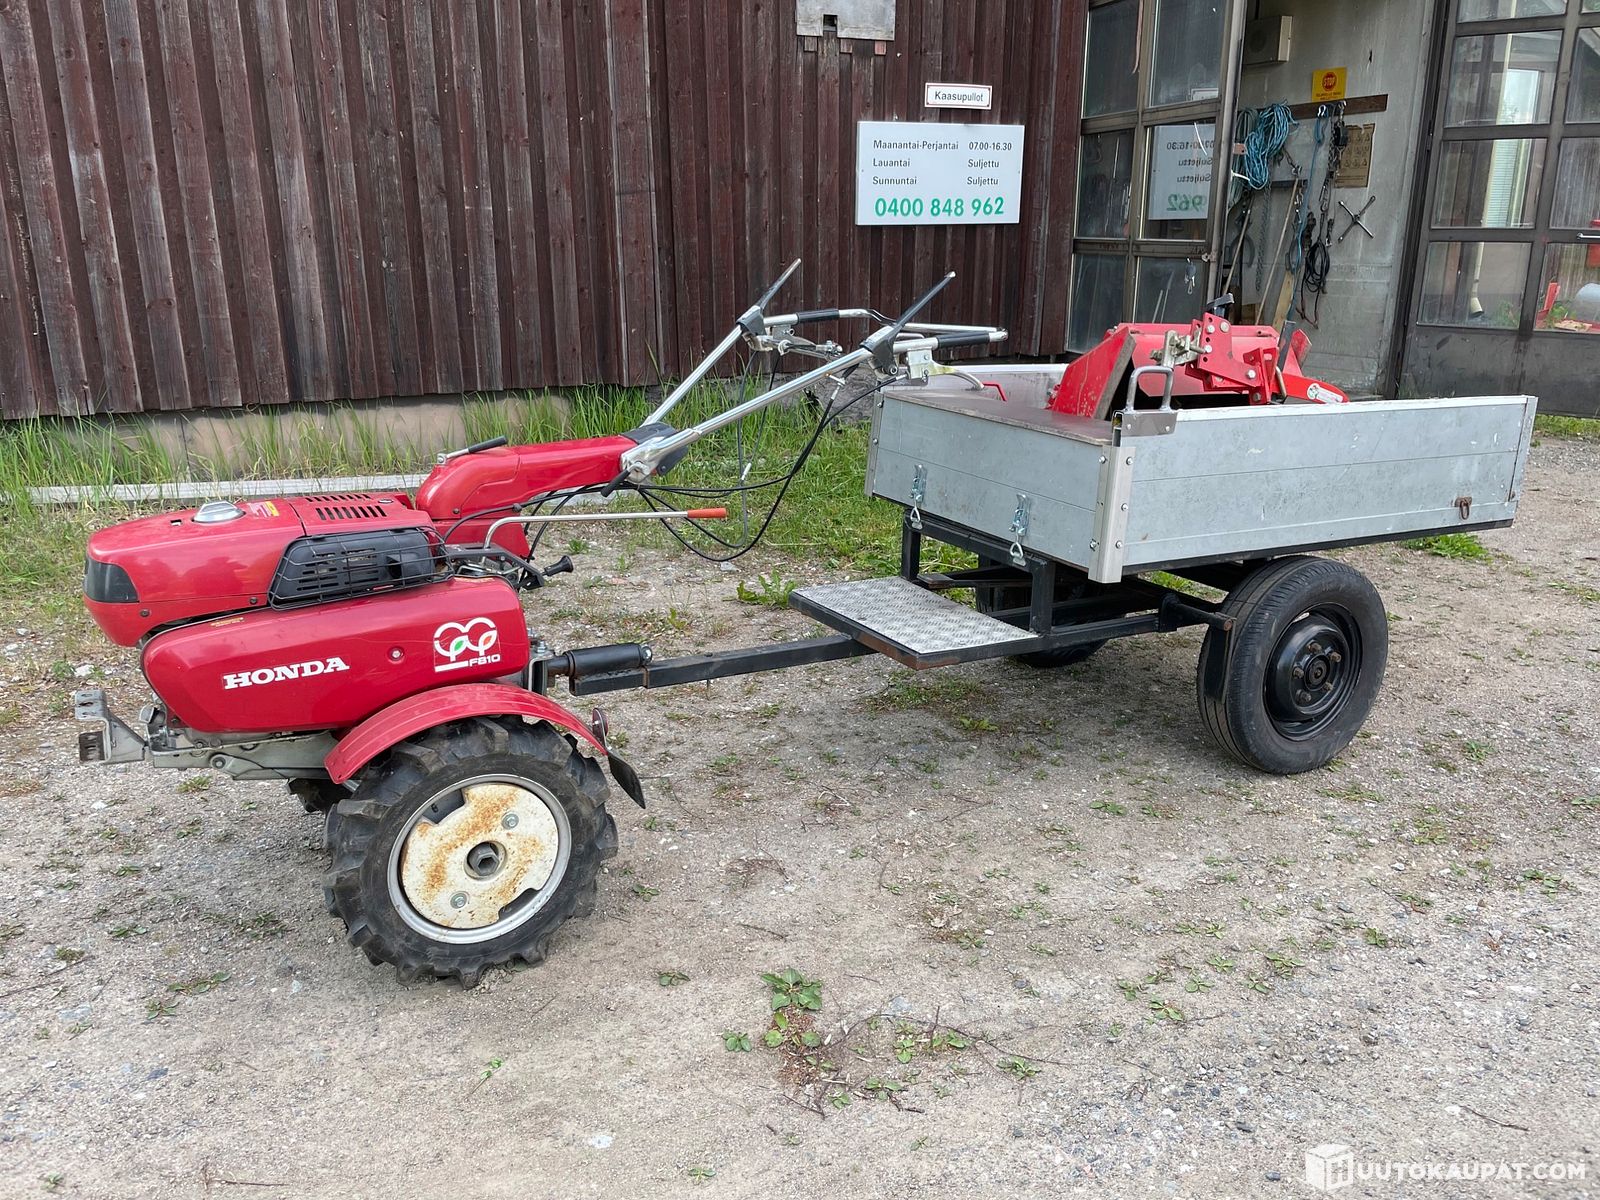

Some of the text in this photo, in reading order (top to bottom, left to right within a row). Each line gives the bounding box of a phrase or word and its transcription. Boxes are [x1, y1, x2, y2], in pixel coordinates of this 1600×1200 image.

[934, 91, 983, 103] Kaasupullot
[873, 140, 959, 151] Maanantai-Perjantai
[872, 158, 1000, 170] Lauantai Suljettu
[872, 176, 999, 187] Sunnuntai Suljettu
[874, 196, 1005, 217] 0400 848 962
[223, 656, 350, 689] HONDA
